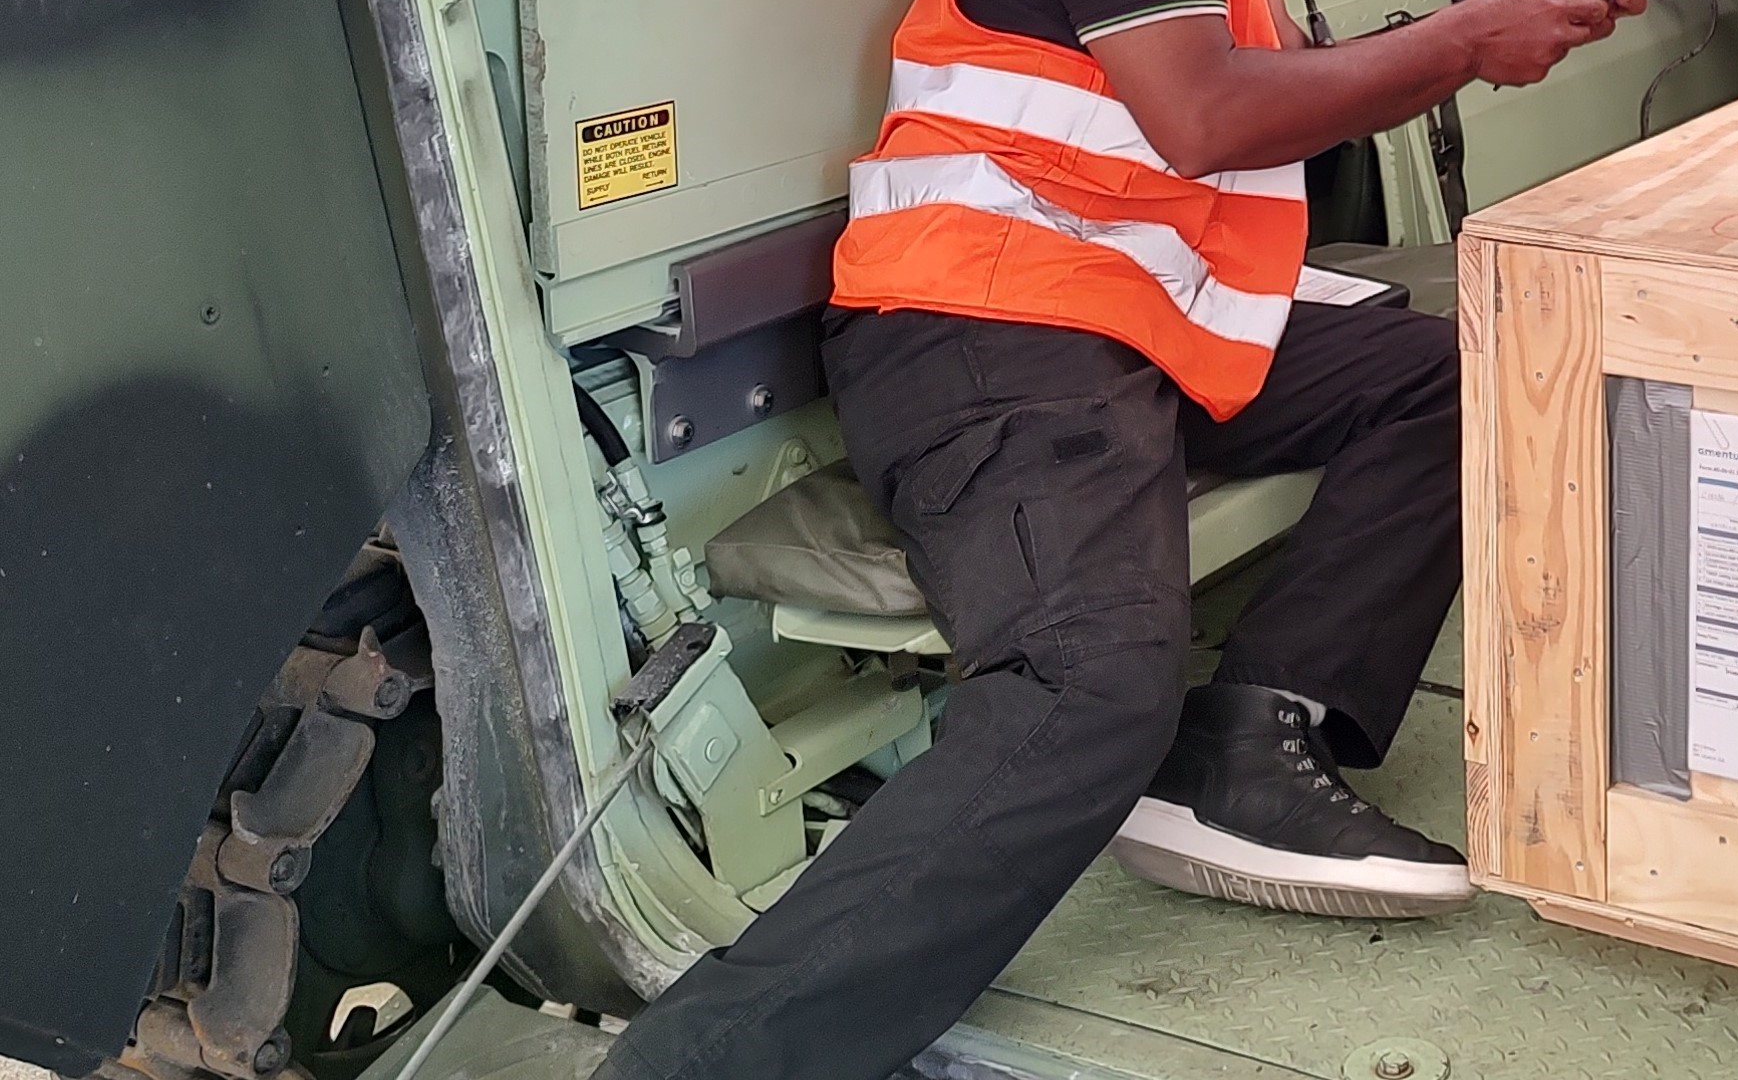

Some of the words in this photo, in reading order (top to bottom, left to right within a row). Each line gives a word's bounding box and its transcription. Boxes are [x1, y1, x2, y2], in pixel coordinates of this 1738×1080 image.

[593, 113, 659, 139] CAUTION
[582, 148, 593, 157] DO
[594, 144, 608, 154] NOT
[609, 137, 639, 150] OPERATE
[640, 131, 666, 143] VEHICLE
[583, 155, 604, 165] WHILE
[605, 151, 623, 160] BOTH
[624, 147, 640, 156] FUEL
[641, 140, 668, 152] RETURN
[583, 164, 603, 174] LINES
[604, 160, 617, 170] ARE
[648, 147, 671, 159] ENGINE
[583, 171, 611, 183] DAMAGE
[612, 167, 628, 176] WILL
[641, 169, 668, 180] RETURN
[586, 182, 611, 195] SUPPLY
